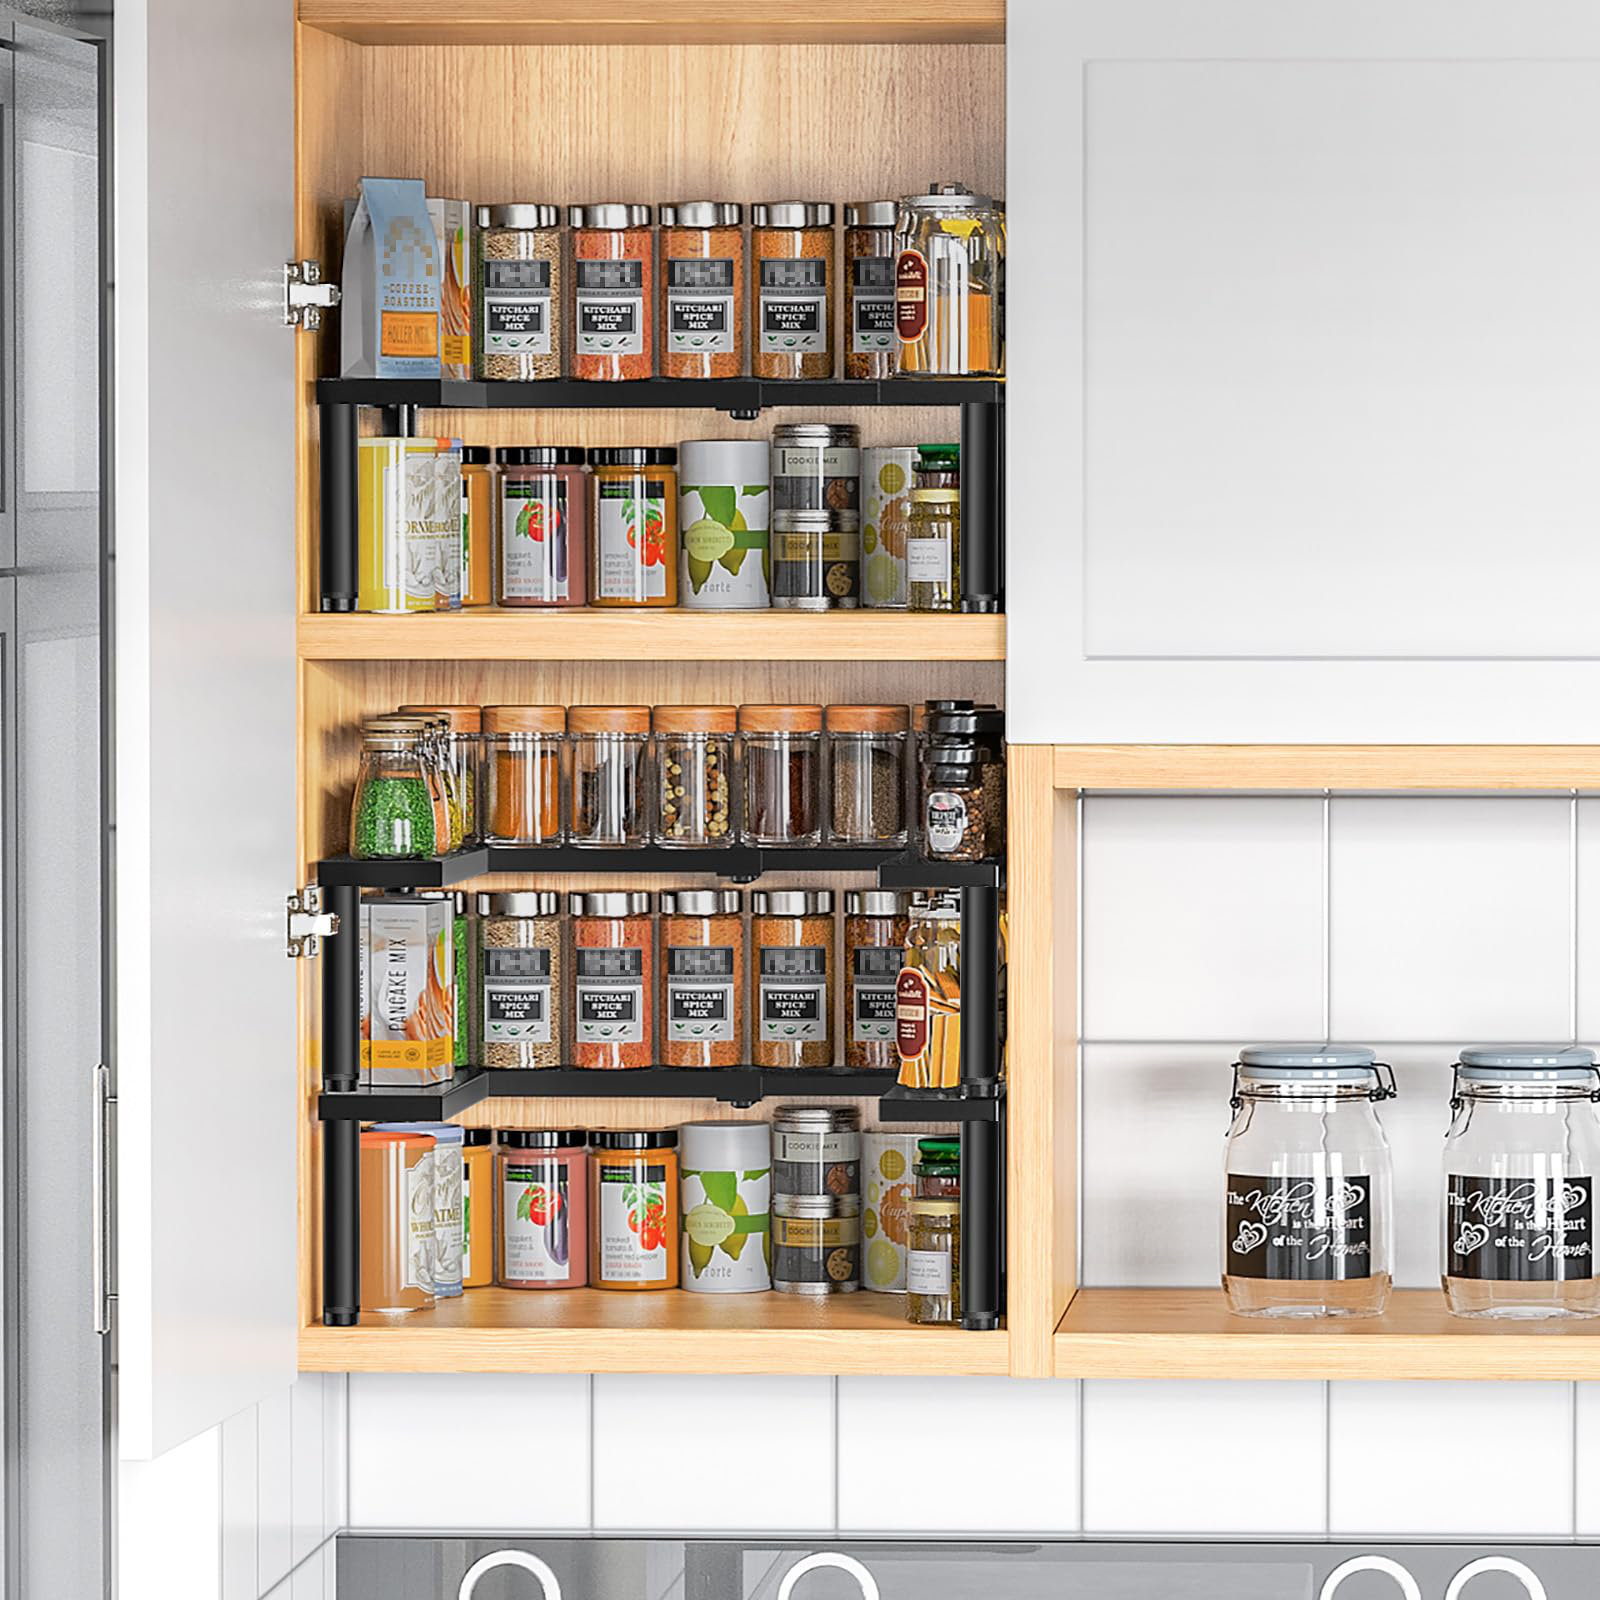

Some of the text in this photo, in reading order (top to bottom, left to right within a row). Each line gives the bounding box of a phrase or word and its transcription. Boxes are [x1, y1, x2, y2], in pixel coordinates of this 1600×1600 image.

[384, 296, 435, 307] ROASTERS
[491, 306, 539, 314] KITCHARI
[583, 306, 631, 314] KITCHARI
[674, 305, 722, 313] KITCHARI
[767, 305, 815, 313] KITCHARI
[499, 314, 531, 322] SPICE
[591, 314, 623, 322] SPICE
[682, 313, 714, 321] SPICE
[775, 313, 806, 321] SPICE
[388, 938, 408, 964] MIX
[388, 969, 408, 1033] PANCAKE
[491, 994, 539, 1002] KITCHARI
[583, 994, 631, 1002] KITCHARI
[674, 993, 722, 1001] KITCHARI
[767, 993, 815, 1001] KITCHARI
[499, 1002, 531, 1010] SPICE
[591, 1002, 623, 1010] SPICE
[682, 1001, 714, 1009] SPICE
[775, 1001, 806, 1009] SPICE
[1227, 1181, 1317, 1226] The Kitchen
[1447, 1182, 1538, 1227] The Kitchen
[1272, 1234, 1286, 1247] of
[1286, 1234, 1304, 1247] the
[1494, 1235, 1507, 1248] of
[1508, 1235, 1526, 1248] the
